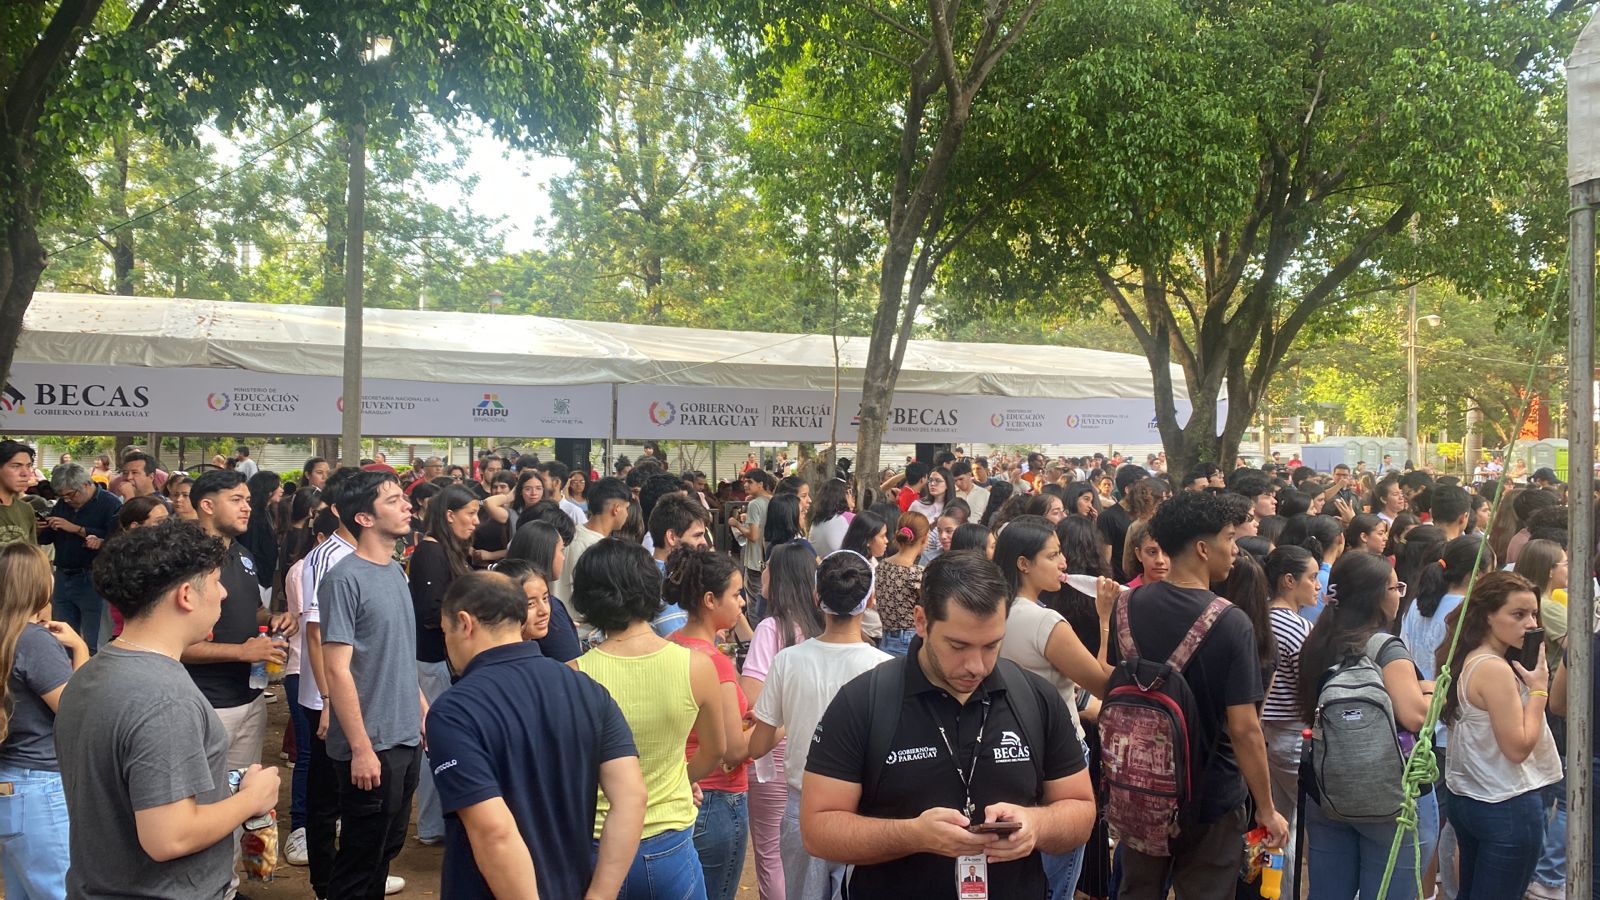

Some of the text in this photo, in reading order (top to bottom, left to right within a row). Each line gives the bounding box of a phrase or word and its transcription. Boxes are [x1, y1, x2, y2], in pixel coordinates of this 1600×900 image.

[34, 383, 149, 408] BECAS
[234, 393, 299, 402] EDUCACIÓN
[235, 403, 295, 412] Y CIENCIAS
[361, 401, 415, 409] JUVENTUD
[680, 402, 744, 414] GOBIERNO
[772, 403, 831, 416] PARAGUÁI
[34, 408, 82, 416] GOBIERNO
[102, 410, 150, 418] PARAGUAY
[472, 408, 509, 417] ITAIPU
[893, 408, 958, 425] BECAS
[680, 414, 759, 427] PARAGUAY
[772, 416, 823, 428] REKUÁI
[897, 747, 928, 755] GOBIERNO
[898, 751, 937, 763] PARAGUAY
[993, 746, 1030, 759] BECAS
